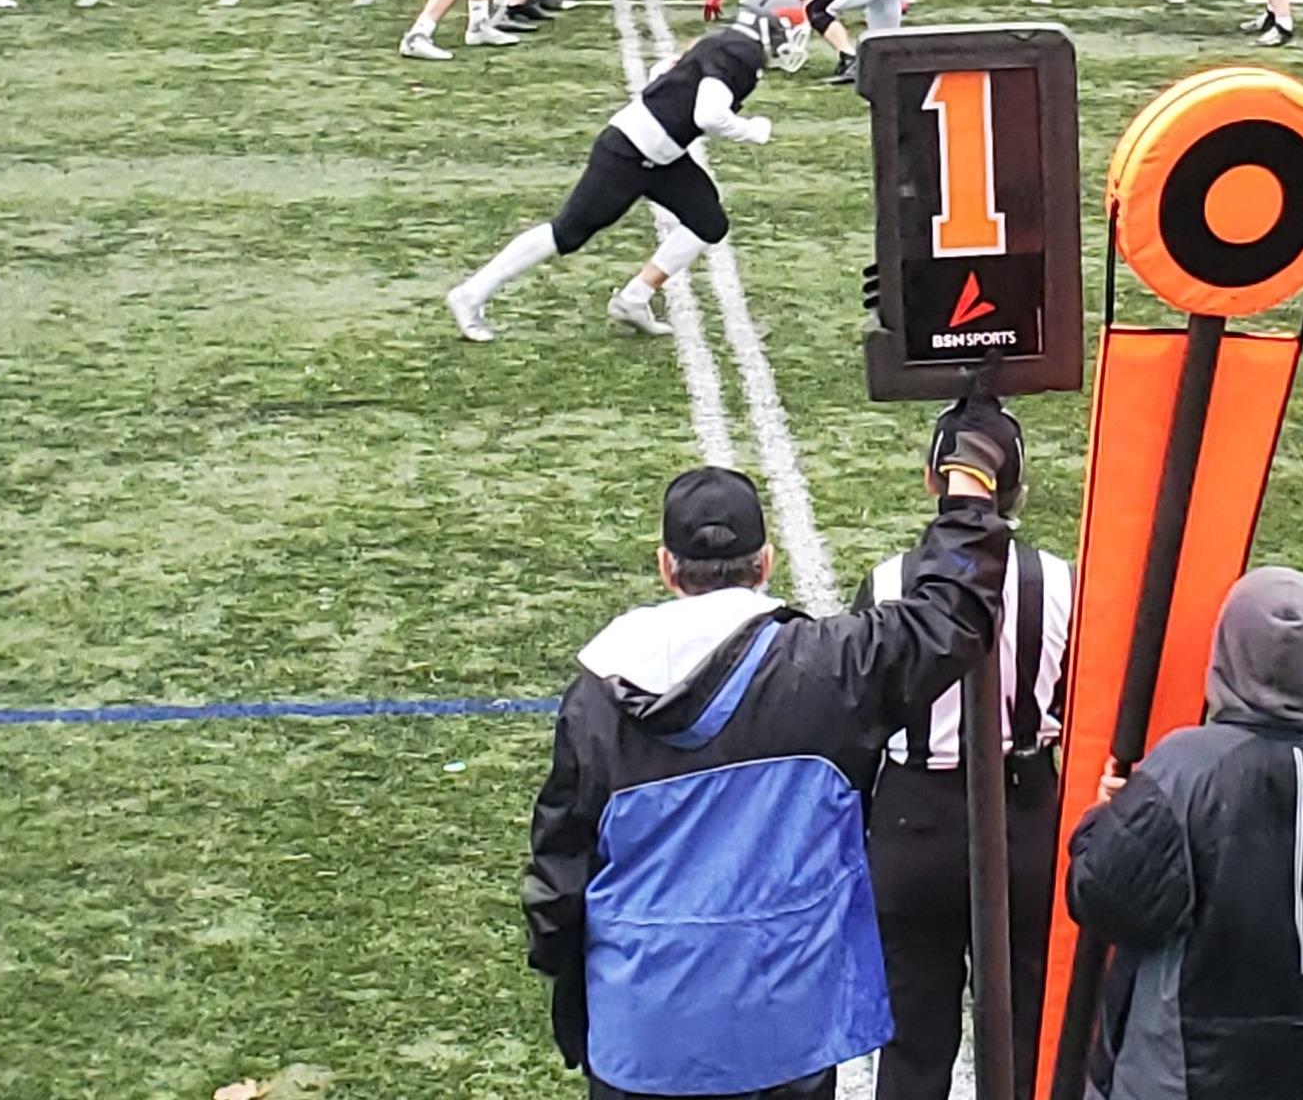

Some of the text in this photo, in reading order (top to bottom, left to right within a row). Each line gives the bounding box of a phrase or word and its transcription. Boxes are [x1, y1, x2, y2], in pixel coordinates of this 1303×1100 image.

[922, 70, 1007, 258] 1
[932, 330, 1017, 349] BSN SPORTS
